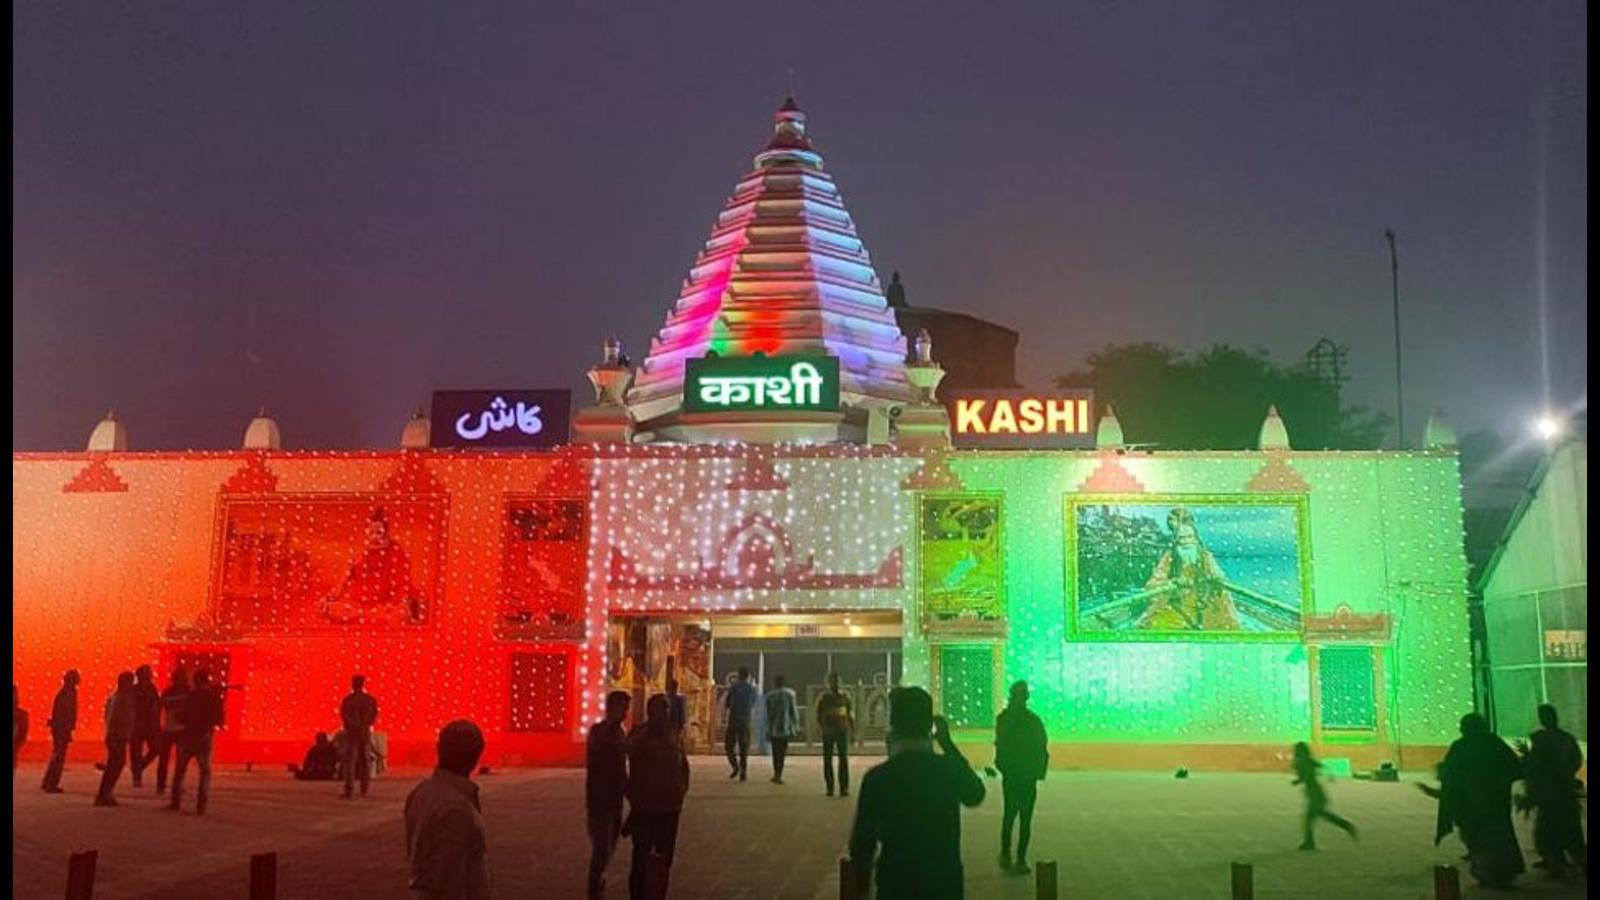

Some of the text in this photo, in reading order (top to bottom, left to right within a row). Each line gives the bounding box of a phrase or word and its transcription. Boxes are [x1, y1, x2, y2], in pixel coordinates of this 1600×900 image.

[699, 362, 823, 405] काशी
[456, 397, 542, 439] کاشی
[957, 399, 1088, 433] KASHI
